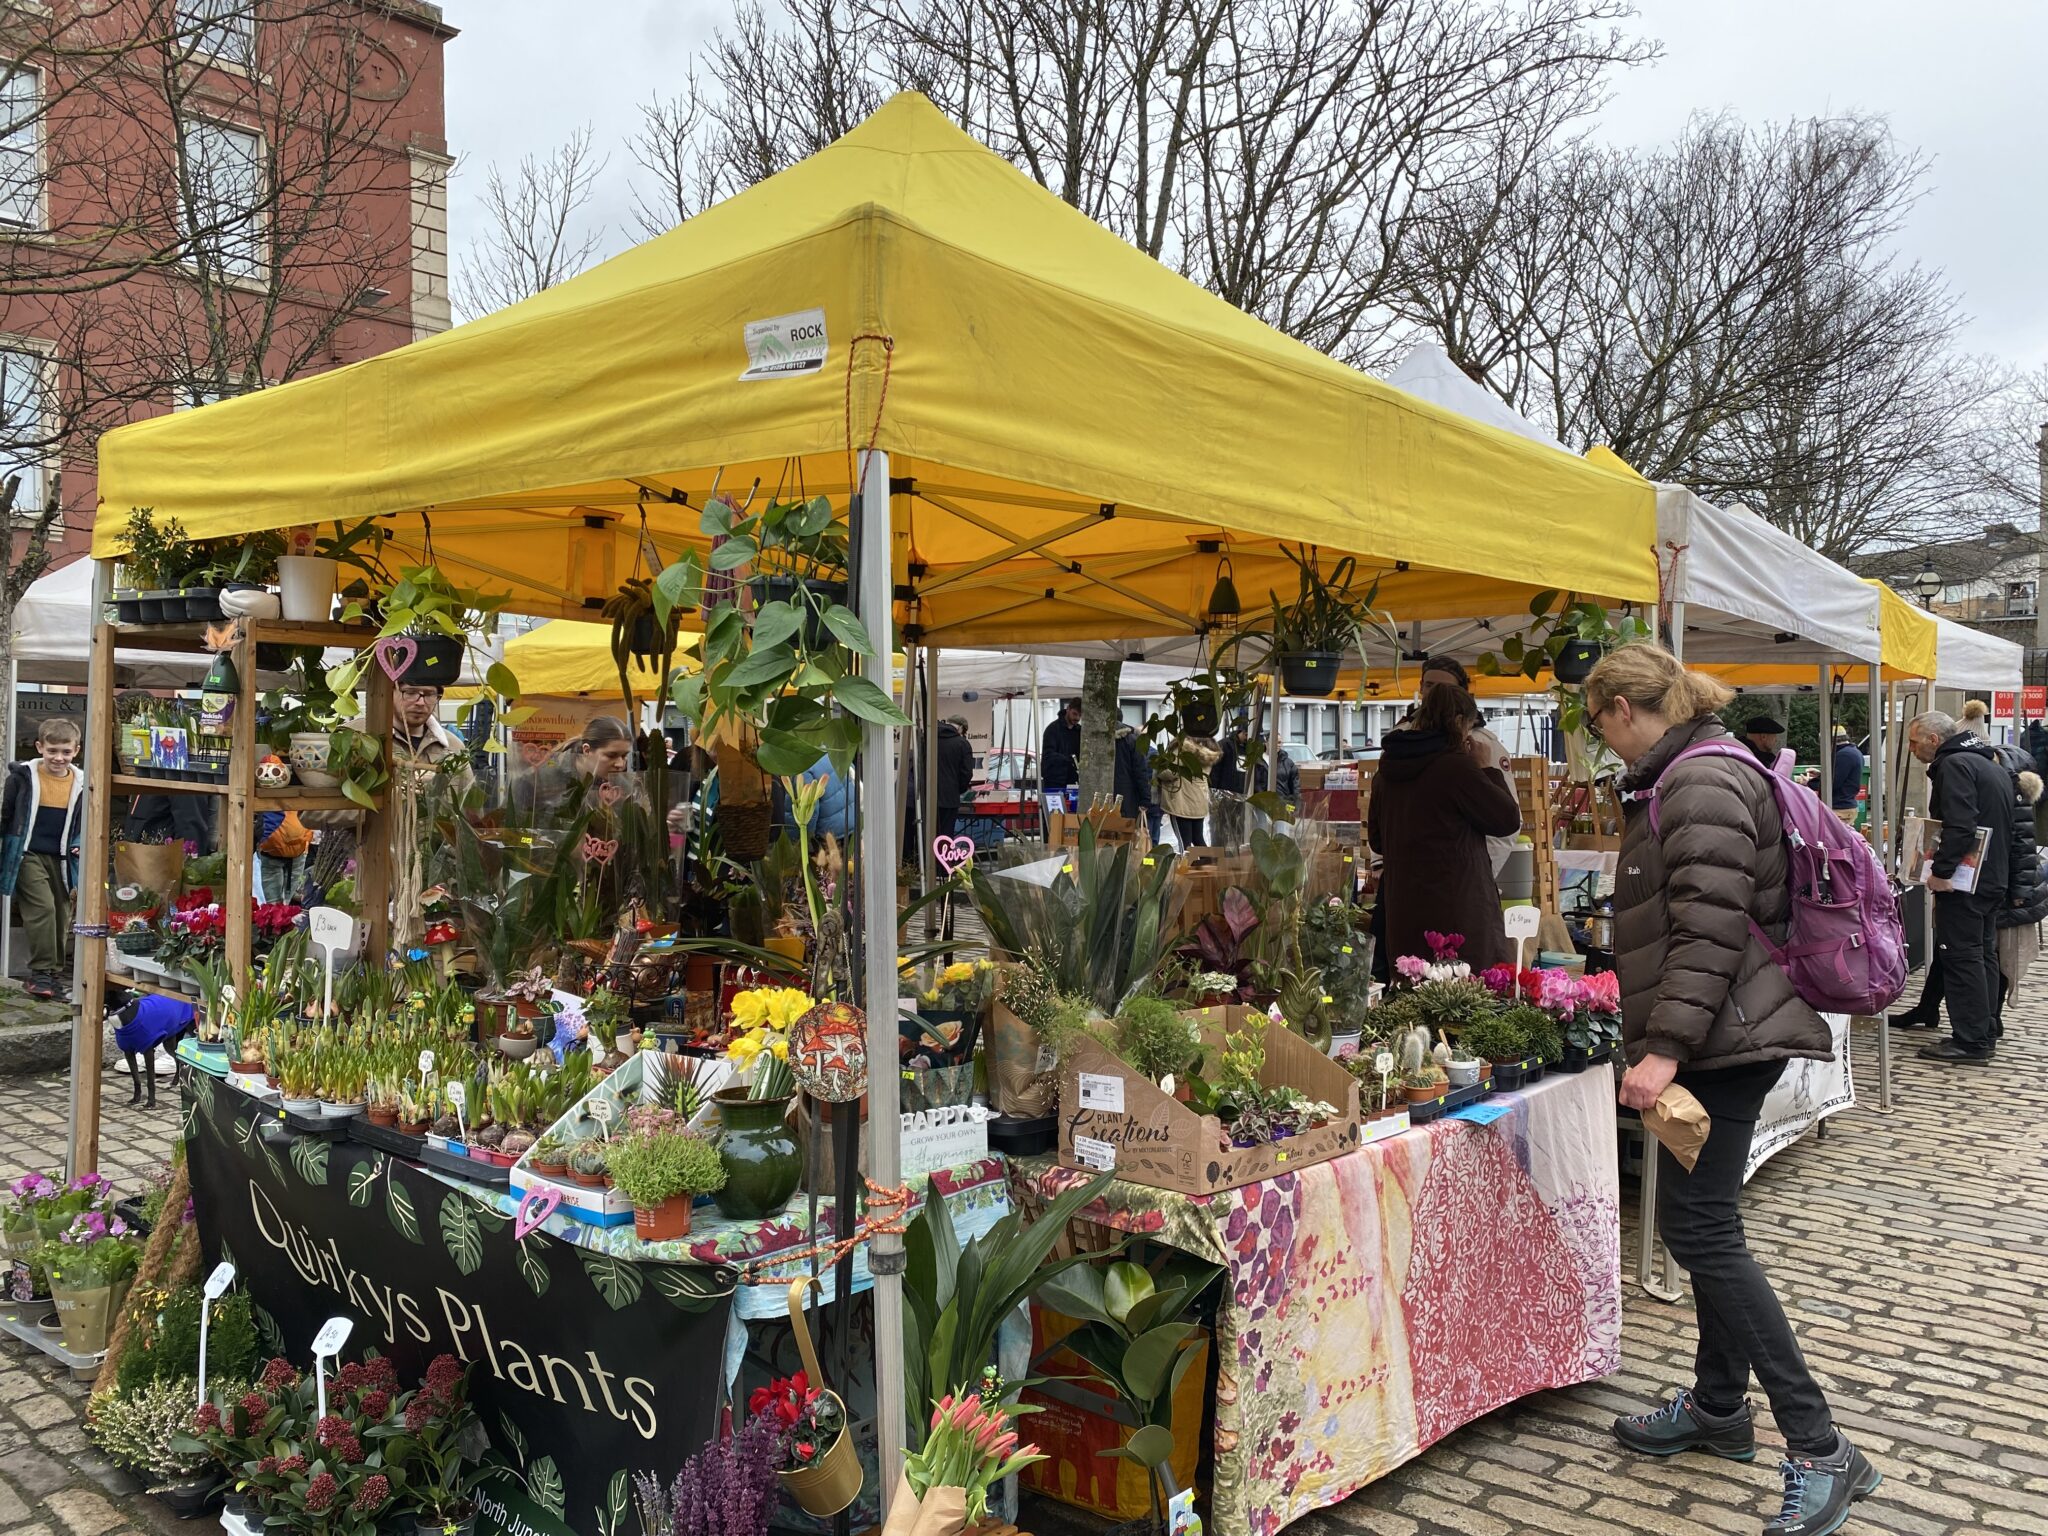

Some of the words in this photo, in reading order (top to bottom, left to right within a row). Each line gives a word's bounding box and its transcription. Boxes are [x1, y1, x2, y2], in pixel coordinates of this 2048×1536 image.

[790, 323, 824, 342] ROCK
[59, 697, 74, 711] &
[940, 843, 969, 861] love
[1628, 865, 1640, 875] Rab
[899, 1104, 969, 1133] HAPPY
[1097, 1113, 1124, 1124] PLANT
[910, 1136, 934, 1146] GROW
[935, 1132, 956, 1142] YOUR
[957, 1127, 976, 1138] OWN
[1066, 1108, 1170, 1154] Creations
[249, 1179, 431, 1344] Quirkys
[436, 1287, 657, 1440] Plants
[475, 1486, 508, 1527] North
